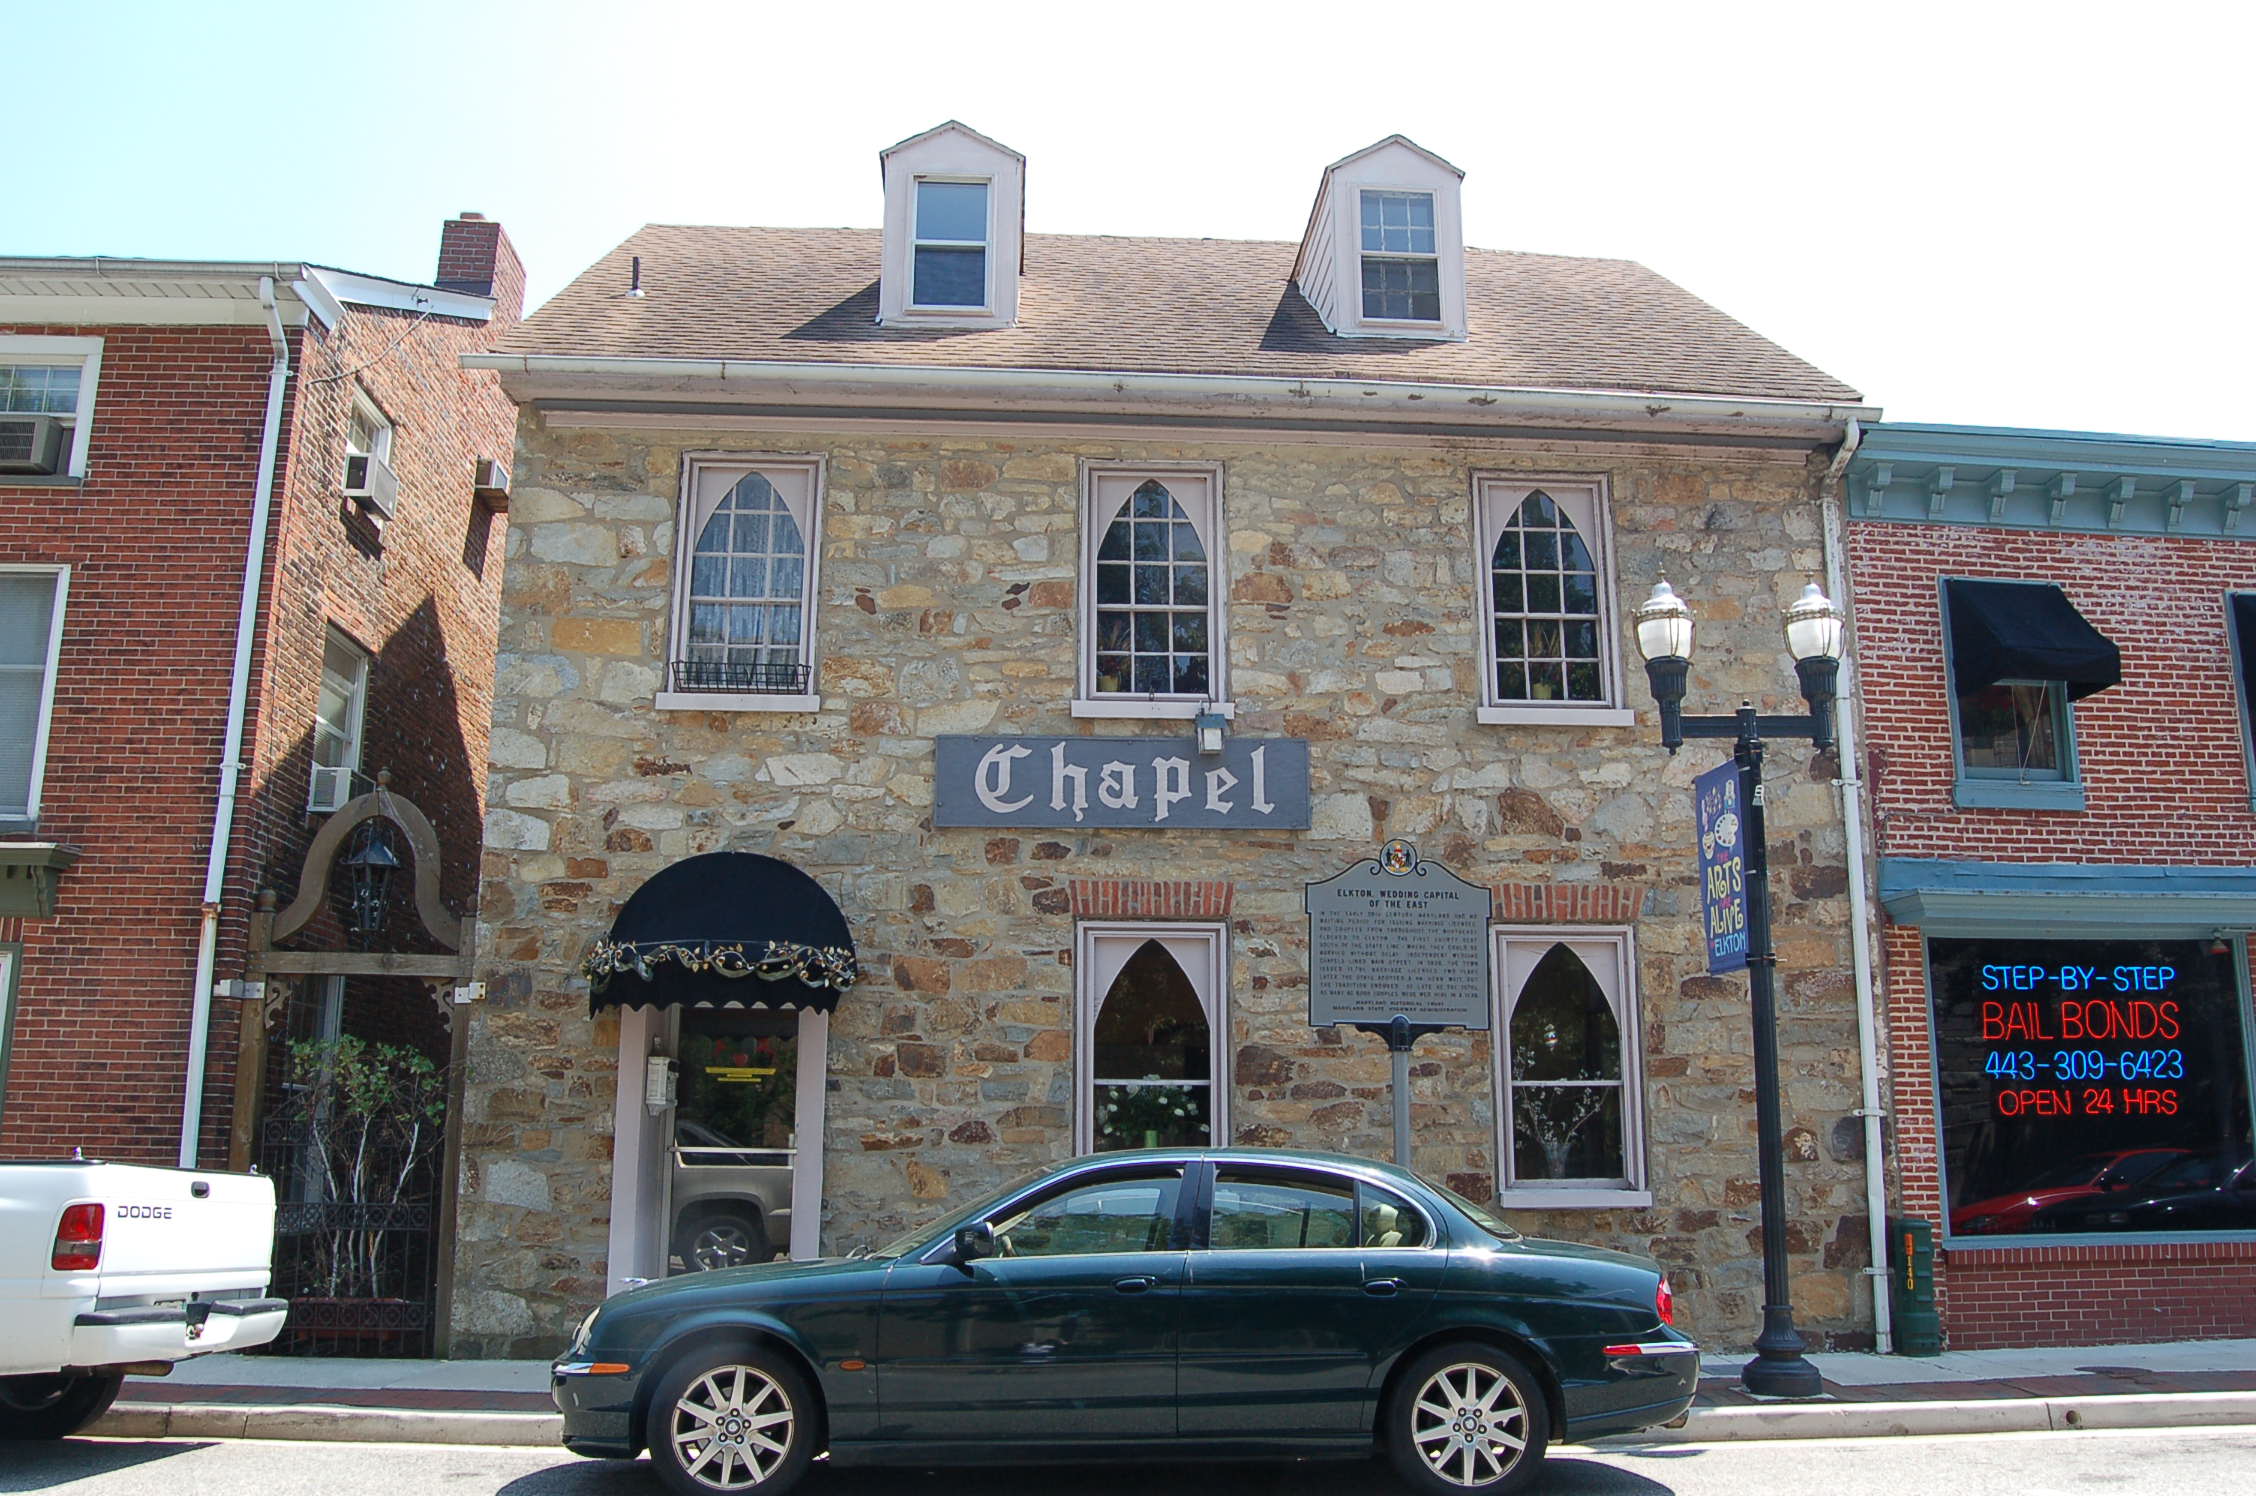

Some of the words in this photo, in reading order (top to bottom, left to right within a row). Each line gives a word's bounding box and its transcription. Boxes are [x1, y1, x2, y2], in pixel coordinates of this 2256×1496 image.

[974, 740, 1275, 823] Chapel
[1707, 856, 1742, 905] ARTS
[1369, 899, 1380, 908] OF
[1385, 900, 1401, 909] THE
[1406, 900, 1429, 909] EAST
[1380, 890, 1419, 899] WEDDING
[1424, 891, 1460, 900] CAPITAL
[1710, 898, 1744, 939] ALIVE
[1714, 931, 1746, 957] ELKTON
[1981, 964, 2176, 992] STEP-BY-STEP
[1982, 1001, 2054, 1041] BAIL
[2062, 1000, 2181, 1041] BONDS
[1985, 1049, 2184, 1081] 443-309-6423
[1998, 1089, 2072, 1116] OPEN
[2083, 1088, 2115, 1115] 24
[2123, 1088, 2179, 1116] HRS
[117, 1205, 173, 1219] DODGE
